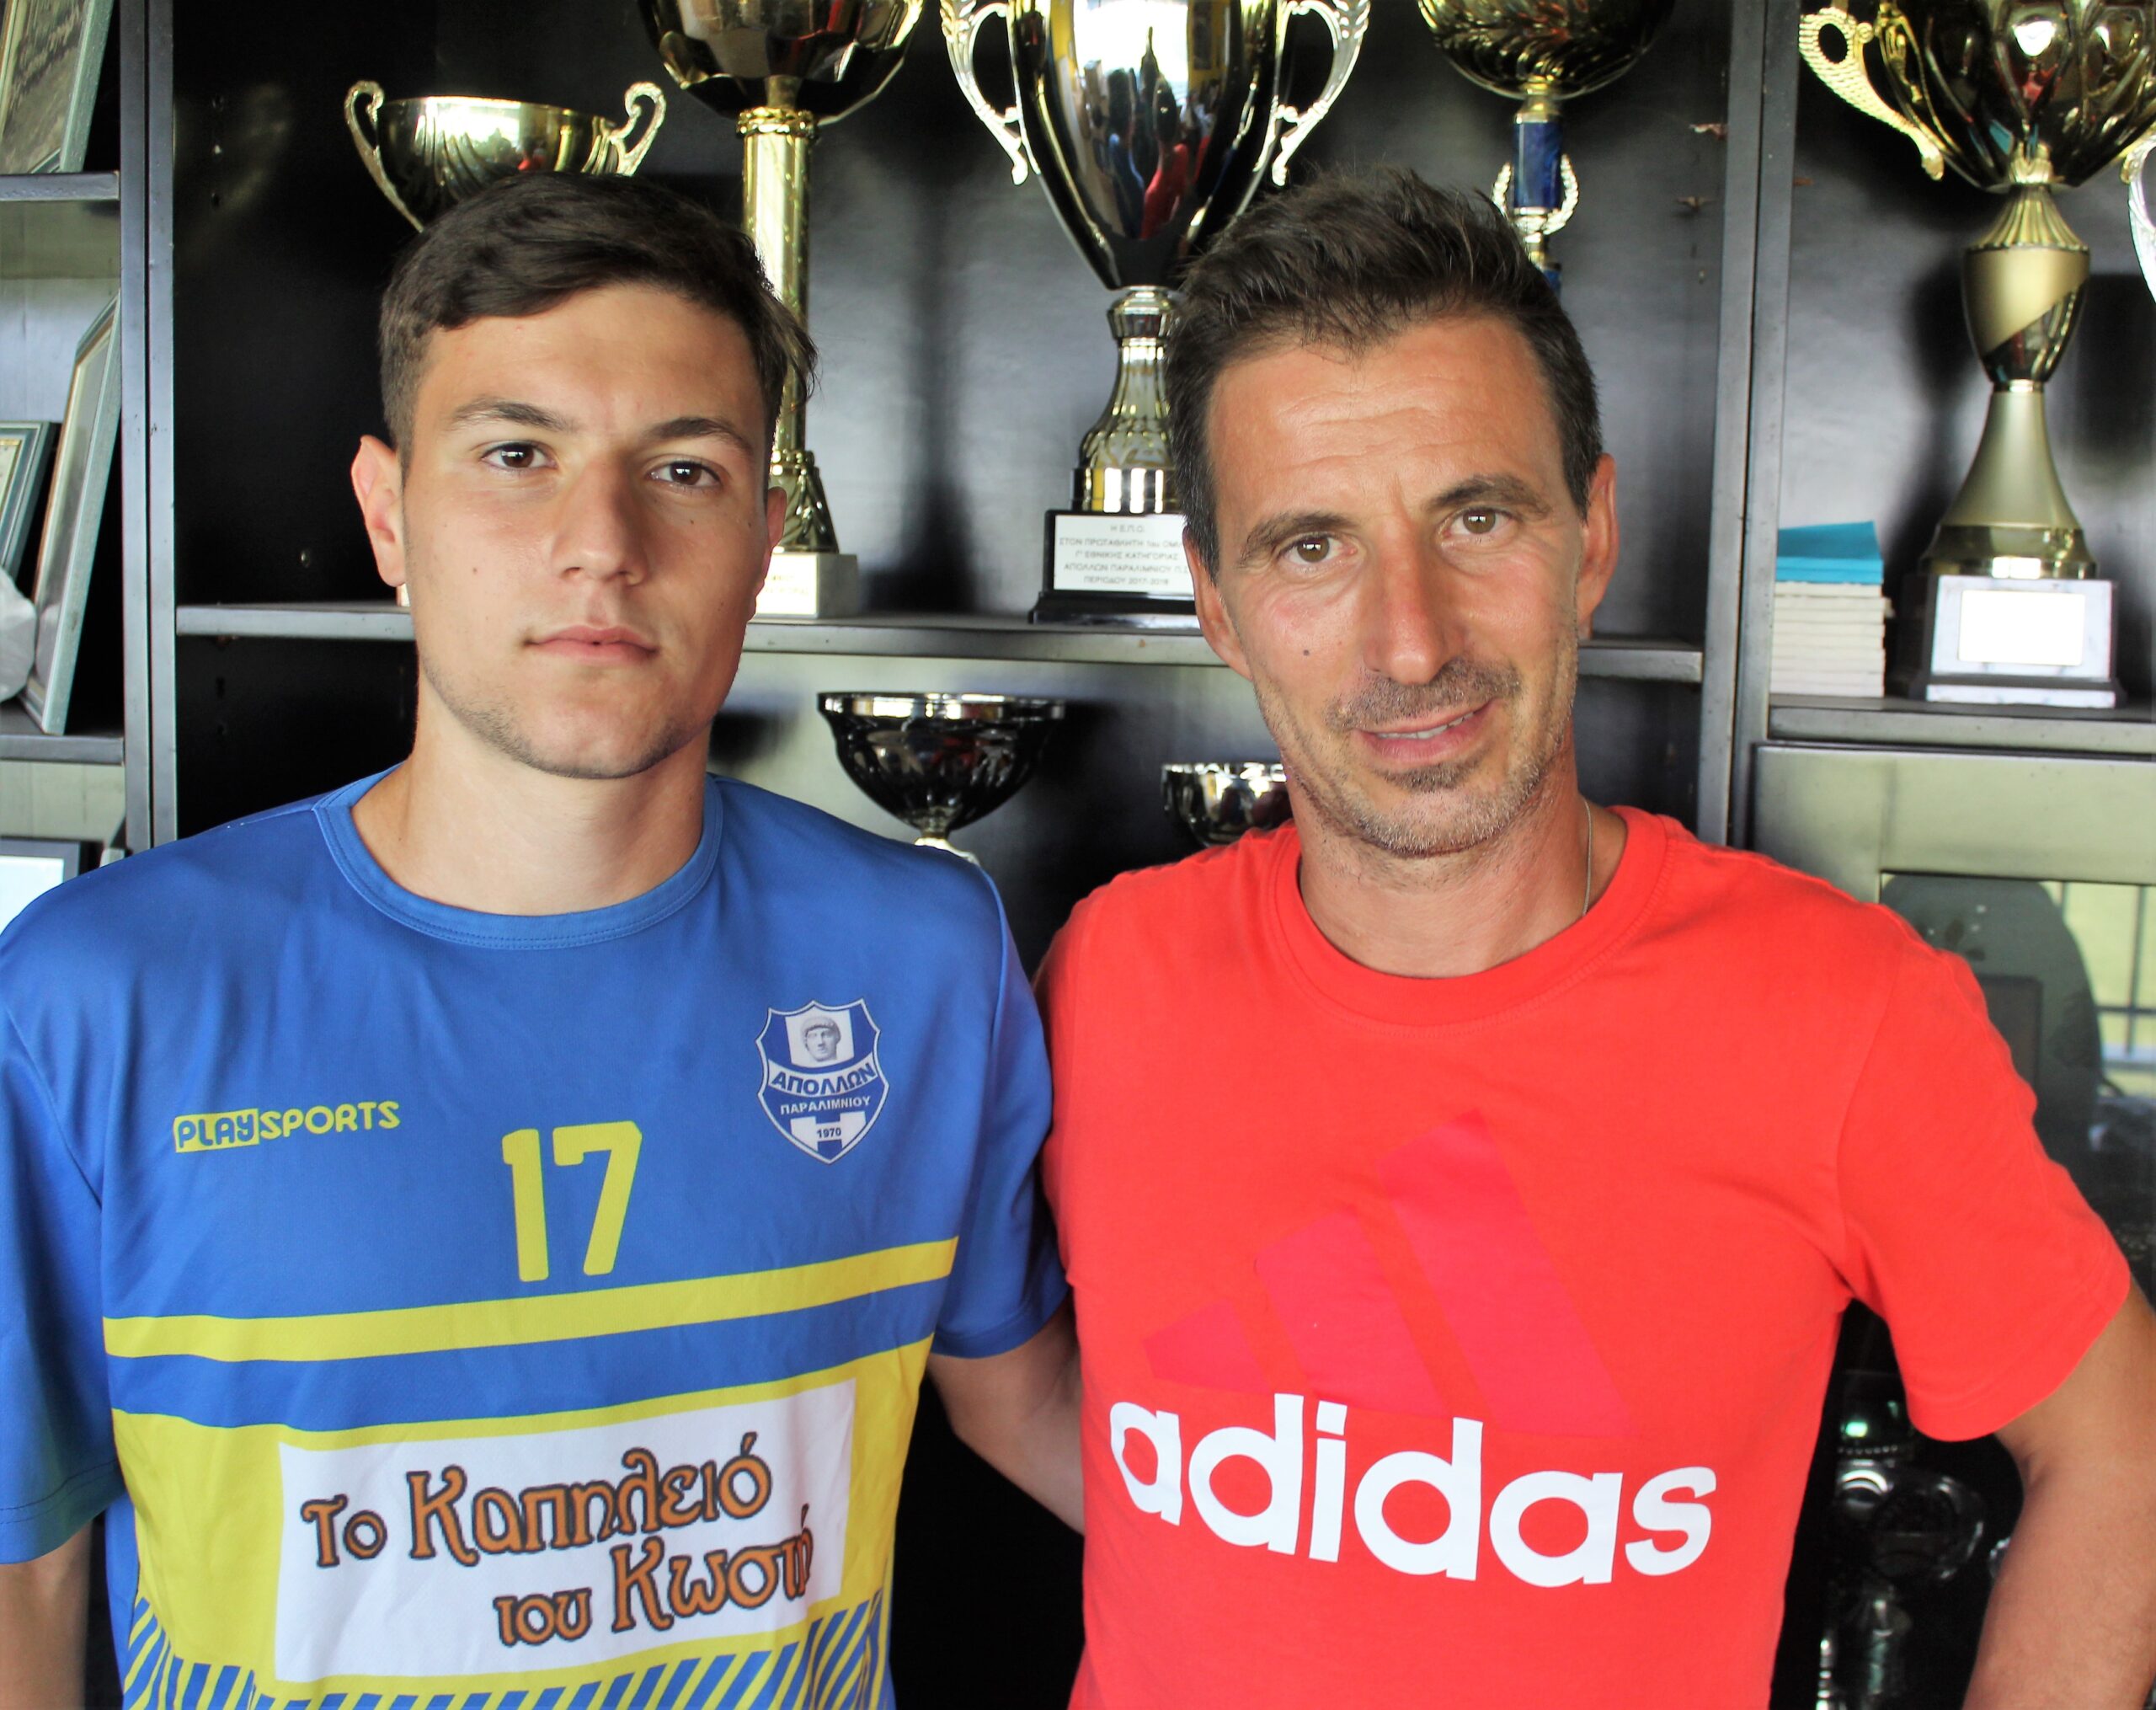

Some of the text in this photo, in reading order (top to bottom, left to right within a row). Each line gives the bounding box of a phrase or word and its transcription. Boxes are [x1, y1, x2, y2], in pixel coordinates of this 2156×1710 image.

[1064, 563, 1108, 571] ΑΠΟΛΛΩΝ
[1110, 564, 1171, 573] ΠΑΡΑΛΙΜΝΙΟΥ
[771, 1062, 876, 1095] ΑΠΟΛΛΩΝ
[780, 1096, 871, 1115] ΠΑΡΑΛΙΜΝΙΟΥ
[817, 1127, 842, 1139] 1970
[502, 1120, 643, 1282] 17
[301, 1432, 772, 1568] Το Καπηλειό
[1110, 1392, 1717, 1588] adidas
[494, 1588, 592, 1647] του
